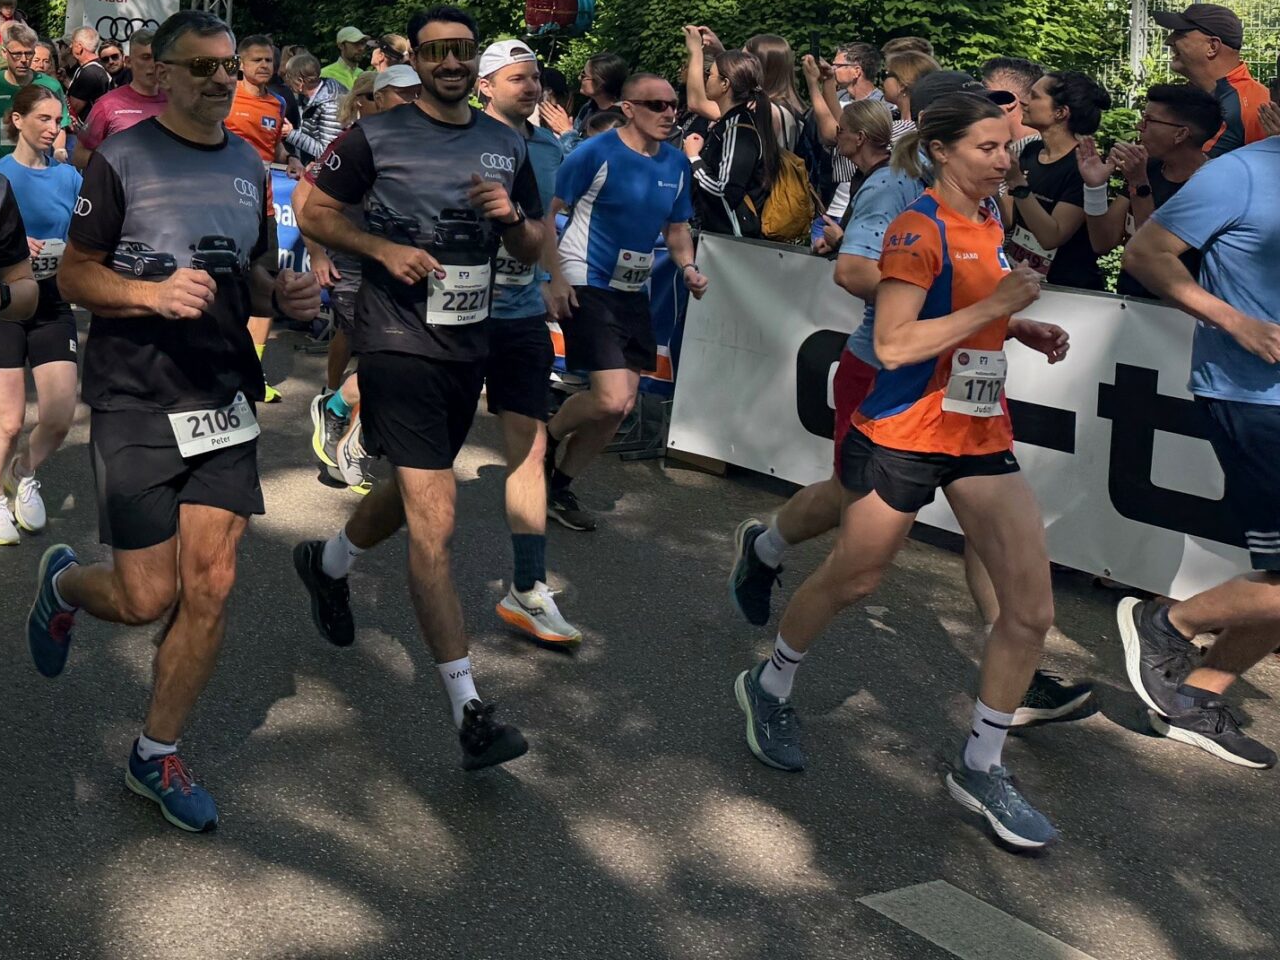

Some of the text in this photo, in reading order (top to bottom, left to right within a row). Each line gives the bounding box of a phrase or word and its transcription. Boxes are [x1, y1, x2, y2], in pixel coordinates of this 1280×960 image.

[442, 288, 487, 311] 2227
[964, 378, 1001, 402] 1712
[187, 407, 241, 438] 2106
[211, 436, 232, 446] Peter
